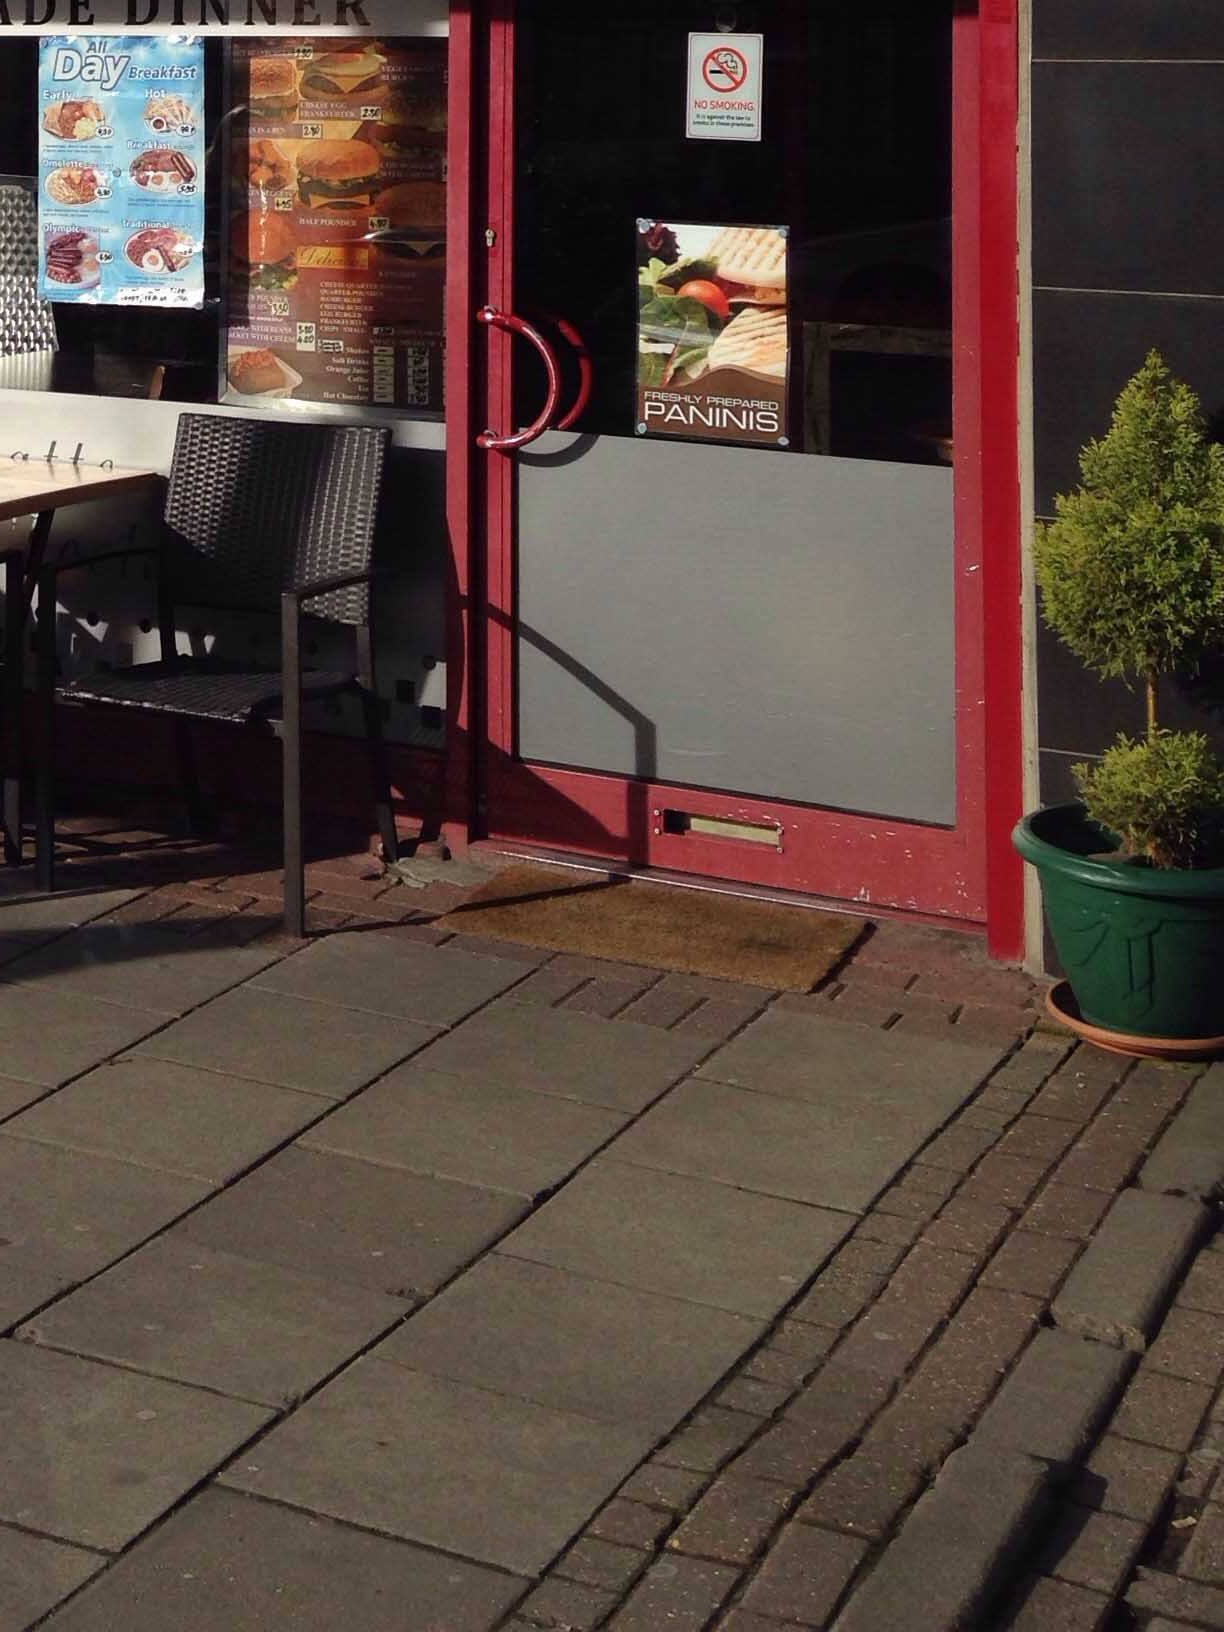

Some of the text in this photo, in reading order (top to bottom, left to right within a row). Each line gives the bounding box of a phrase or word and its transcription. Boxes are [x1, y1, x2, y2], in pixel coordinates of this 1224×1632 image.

[86, 41, 108, 54] All
[52, 48, 197, 91] Day Breakfast
[694, 100, 708, 110] NO
[644, 391, 779, 411] FRESHLY PREPARED
[644, 401, 779, 433] PANINIS
